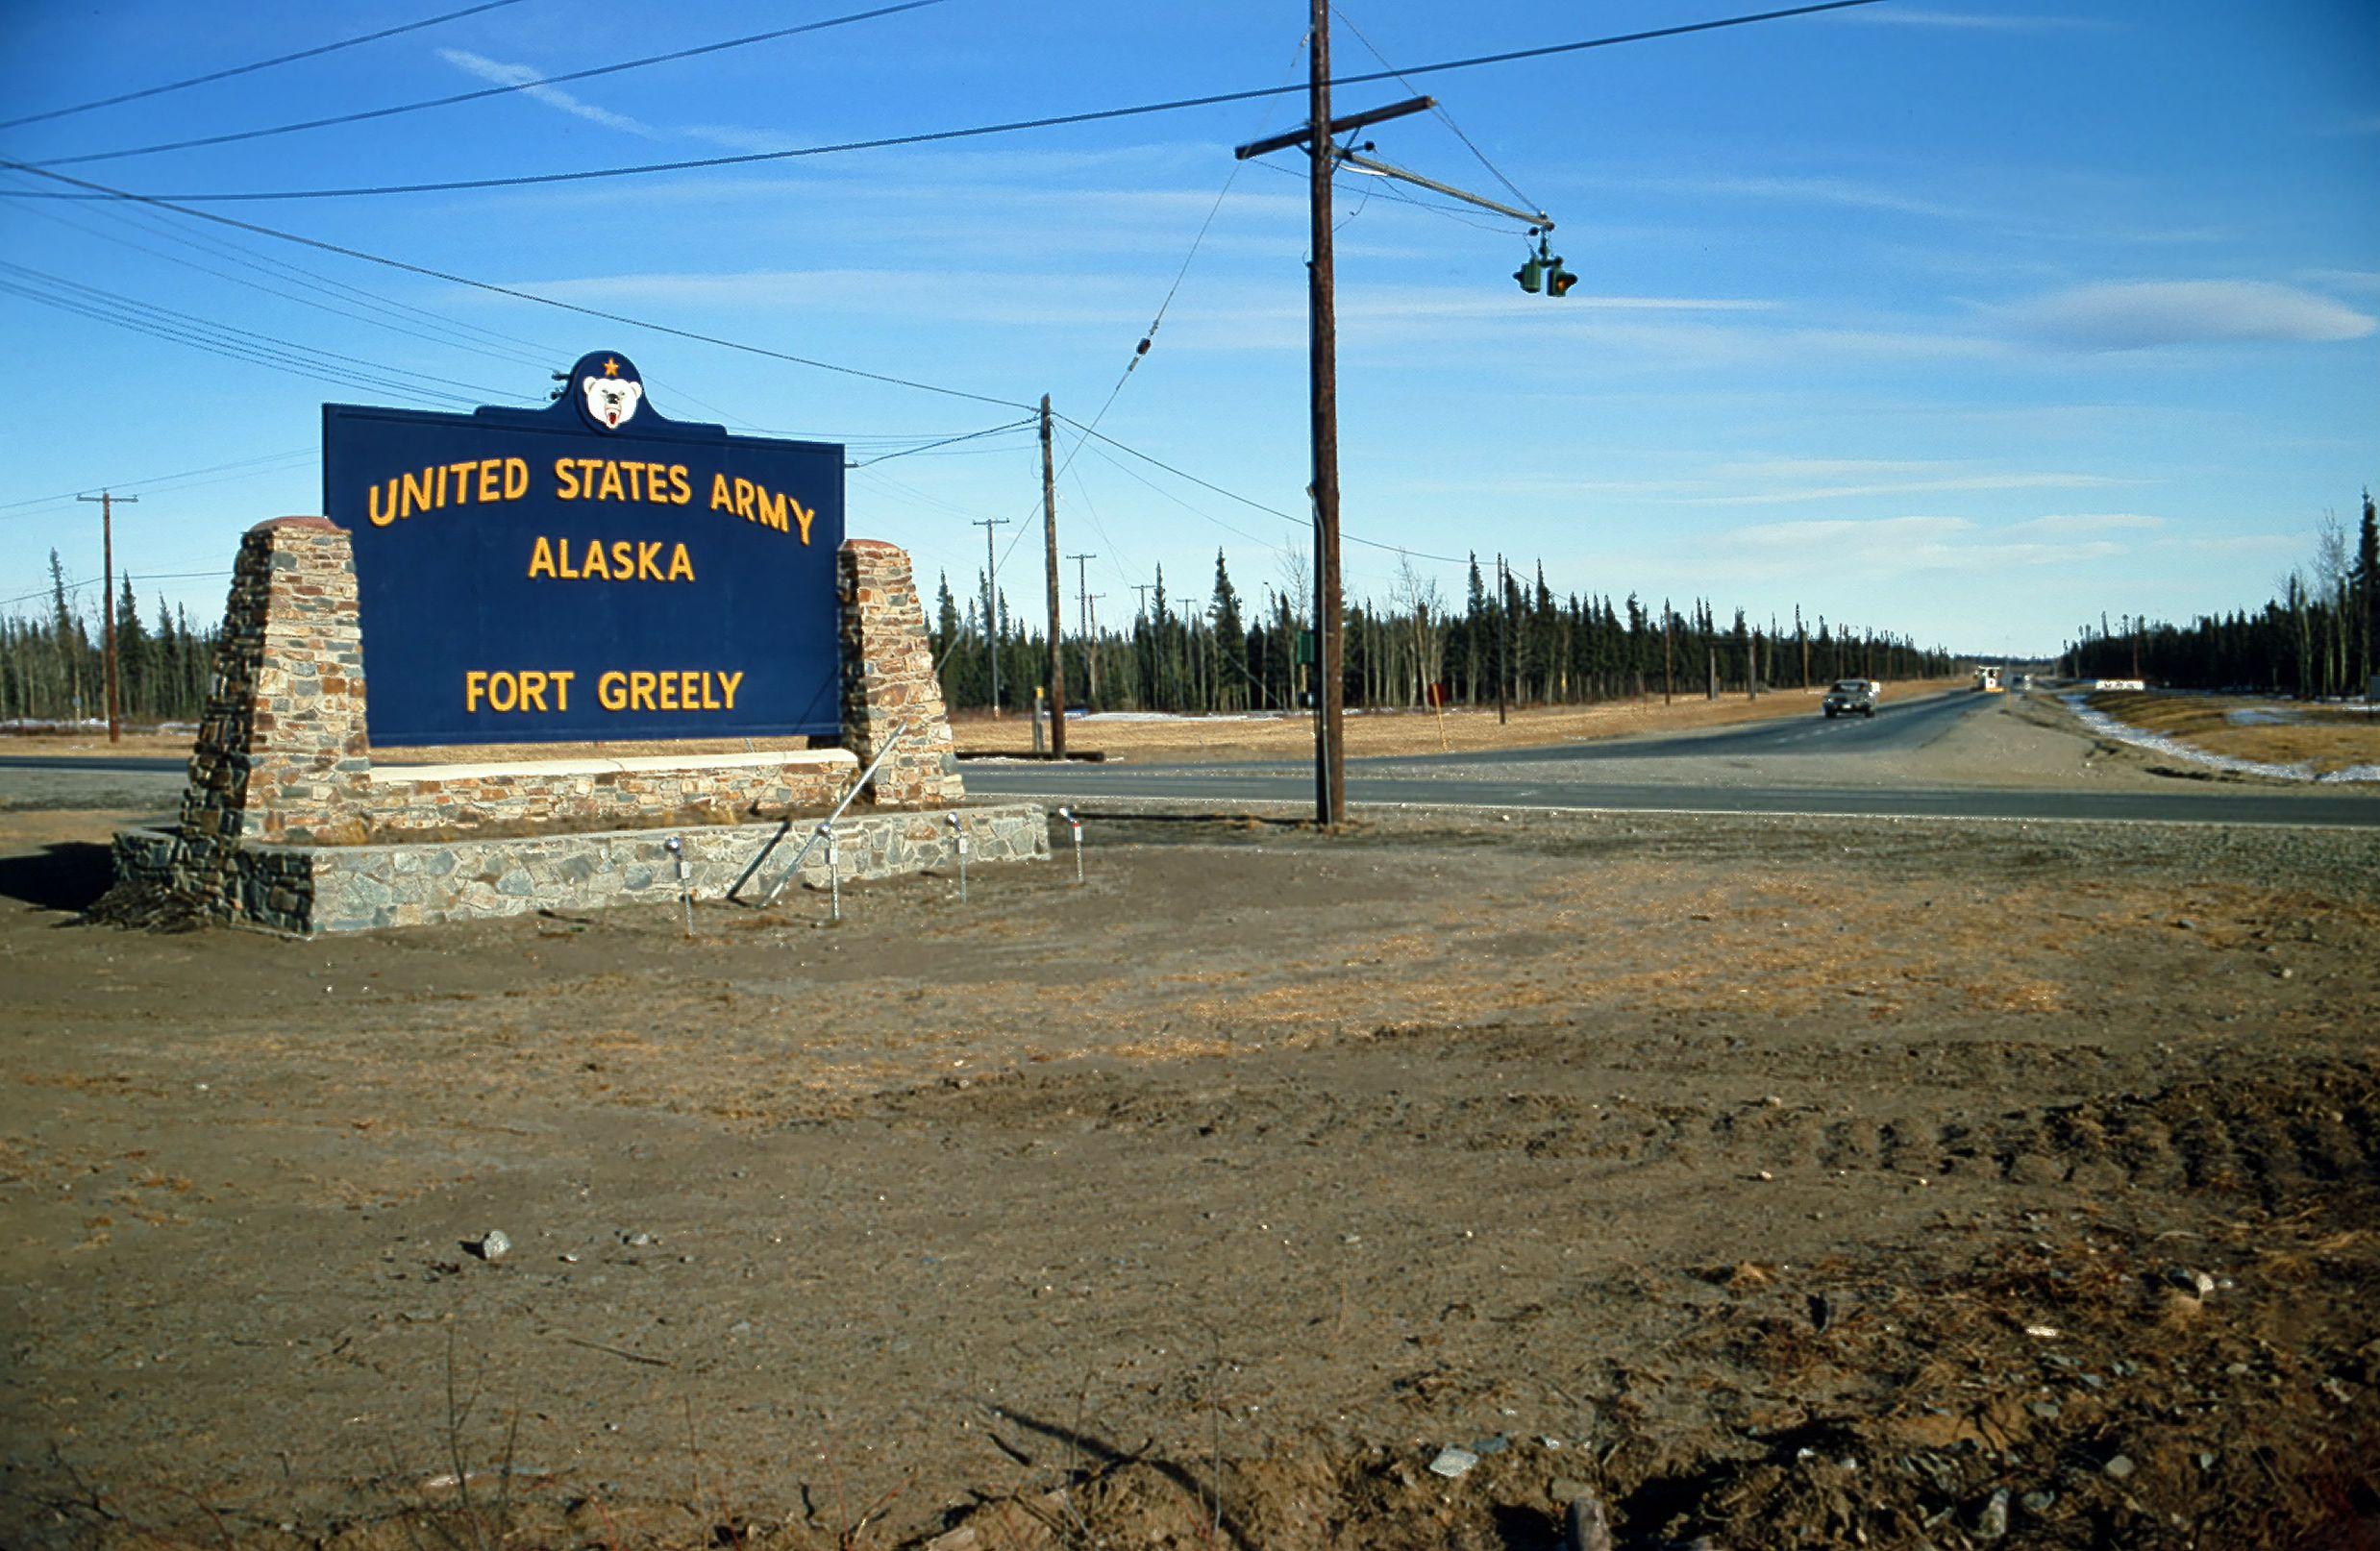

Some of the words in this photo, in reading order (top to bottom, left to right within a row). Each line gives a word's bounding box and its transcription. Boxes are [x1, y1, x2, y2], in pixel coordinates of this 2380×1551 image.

[368, 456, 529, 527] UNITED
[554, 456, 692, 505] STATES
[709, 473, 815, 546] ARMY
[528, 536, 696, 581] ALASKA
[465, 670, 576, 712] FORT
[597, 670, 744, 711] GREELY
